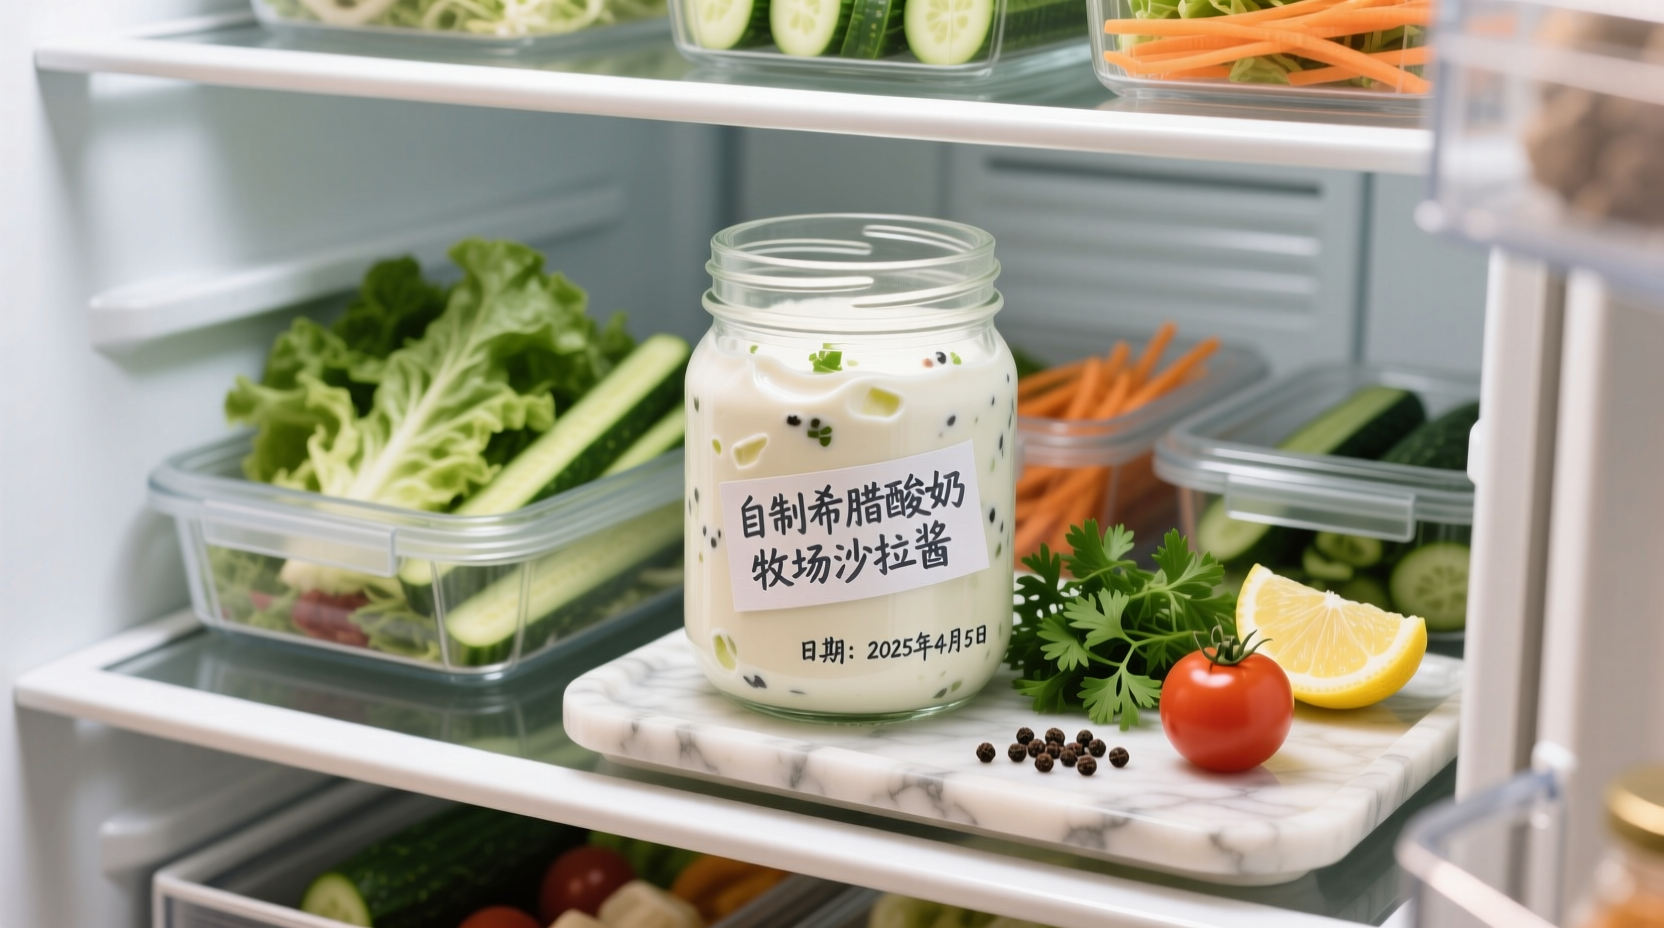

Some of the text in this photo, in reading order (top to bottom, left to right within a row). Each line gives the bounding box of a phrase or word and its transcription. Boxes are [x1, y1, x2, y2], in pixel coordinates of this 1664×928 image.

[740, 470, 966, 539] 自制希腊酸奶
[752, 519, 952, 591] 牧场沙拉酱
